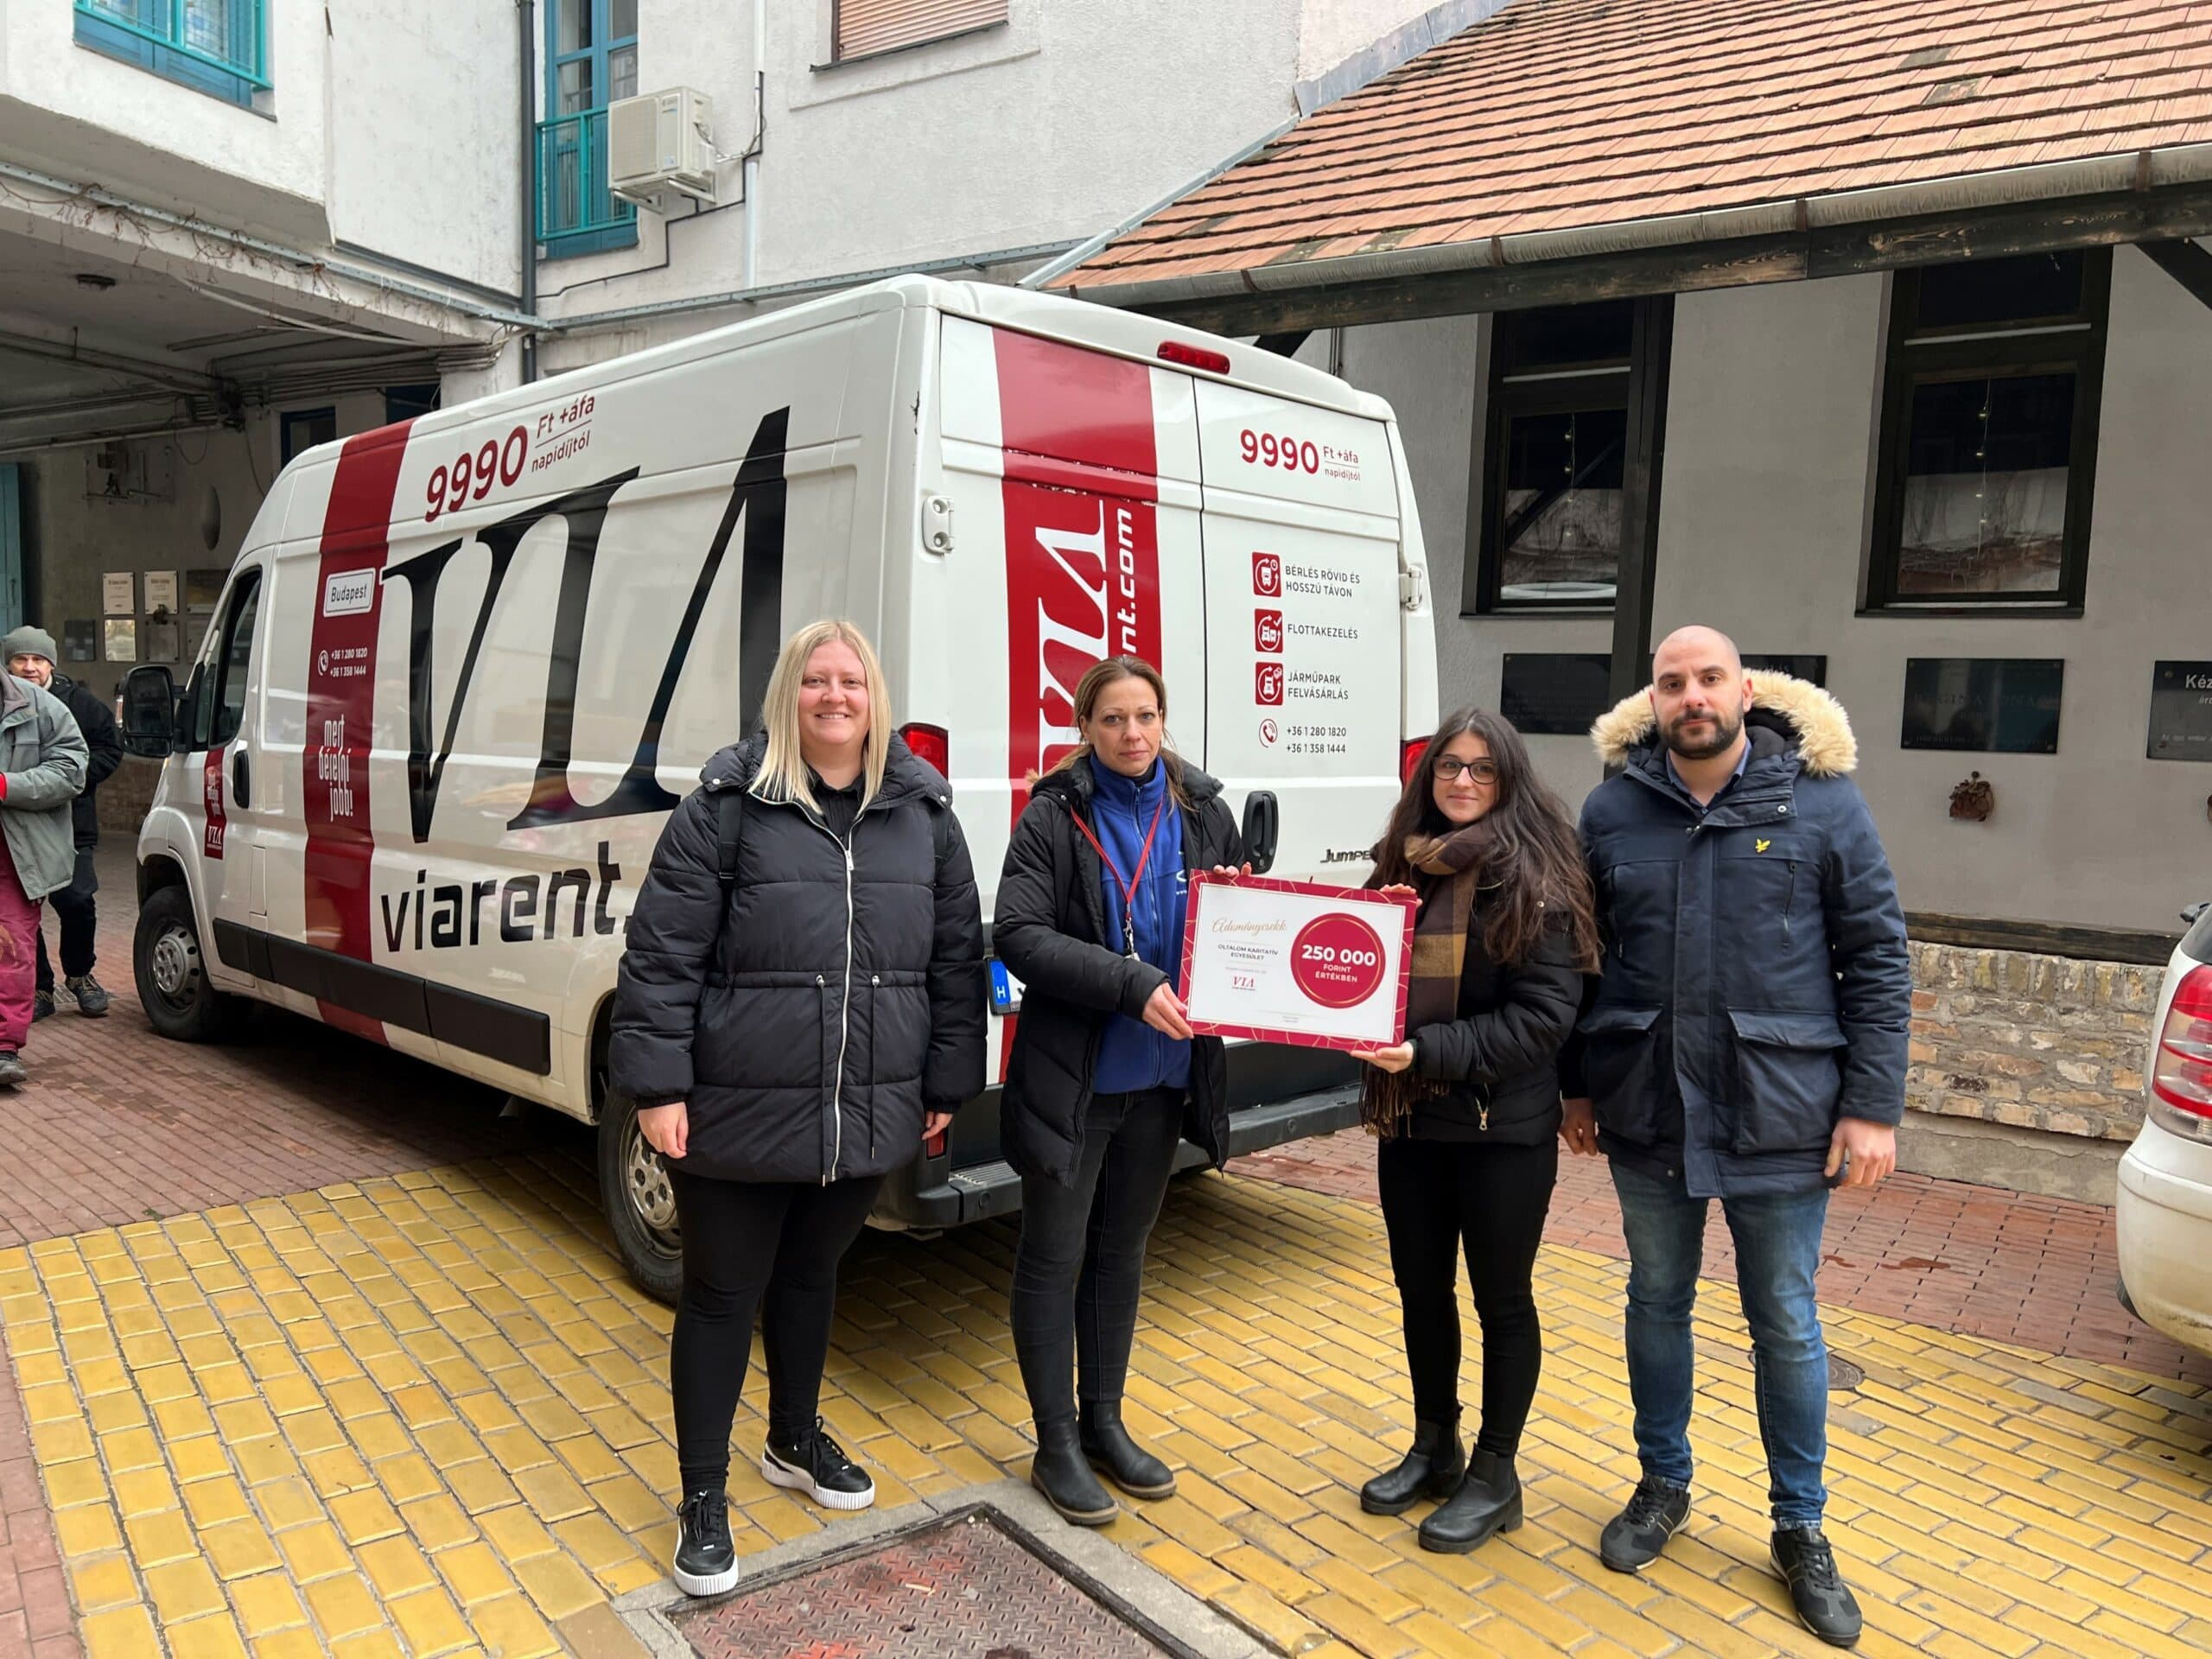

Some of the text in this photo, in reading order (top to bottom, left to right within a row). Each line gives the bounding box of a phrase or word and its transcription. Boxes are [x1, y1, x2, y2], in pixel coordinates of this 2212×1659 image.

[537, 394, 595, 438] Ft +áfa
[531, 429, 591, 473] napidíjtól
[1240, 429, 1319, 474] 9990
[1323, 446, 1359, 464] Ft +áfa
[424, 425, 528, 523] 9990
[1325, 467, 1361, 481] napidíjtól
[1285, 564, 1361, 584] BÉRLÉS RÖVID ÉS
[330, 583, 367, 604] Budapest
[1286, 582, 1352, 598] HOSSZÚ TÁVON
[382, 405, 791, 843] VIA
[1287, 623, 1358, 639] FLOTTAKEZELÉS
[1287, 687, 1349, 700] FELVÁSÁRLÁS
[324, 714, 345, 747] mert
[1287, 727, 1302, 736] +36
[1310, 727, 1326, 736] 280
[1328, 727, 1347, 737] 1820
[1287, 744, 1302, 753] +36
[1310, 744, 1325, 753] 358
[1327, 744, 1346, 753] 1444
[1217, 944, 1246, 952] OLTALOM
[1230, 951, 1264, 961] EGYESÜLET
[1301, 944, 1376, 966] 250 000
[1315, 970, 1357, 982] ÉRTÉKBEN
[1323, 963, 1351, 973] FORINT
[1232, 976, 1255, 988] VIA
[996, 985, 1006, 999] H
